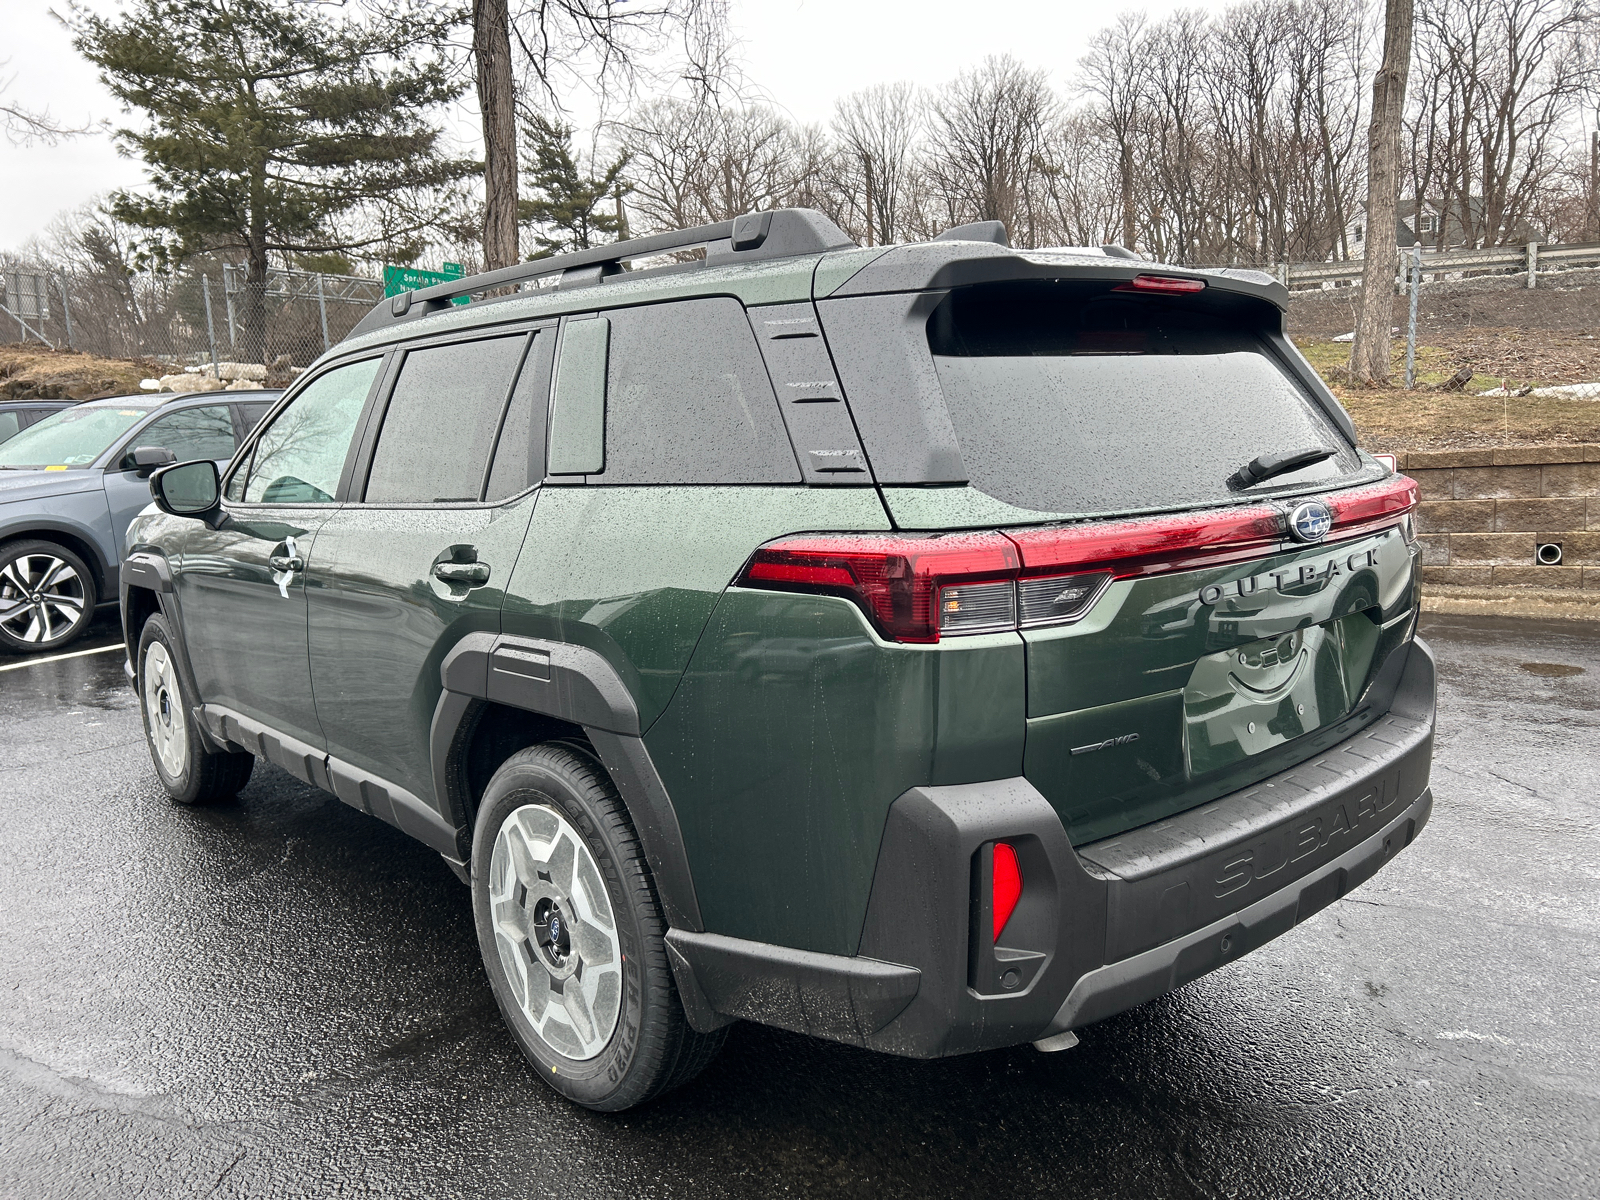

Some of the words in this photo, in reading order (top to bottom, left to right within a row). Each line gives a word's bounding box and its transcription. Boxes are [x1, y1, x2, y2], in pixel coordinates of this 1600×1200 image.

[1199, 549, 1379, 606] OUTBACK
[1098, 732, 1140, 751] AWD
[1214, 769, 1401, 899] SUBARU
